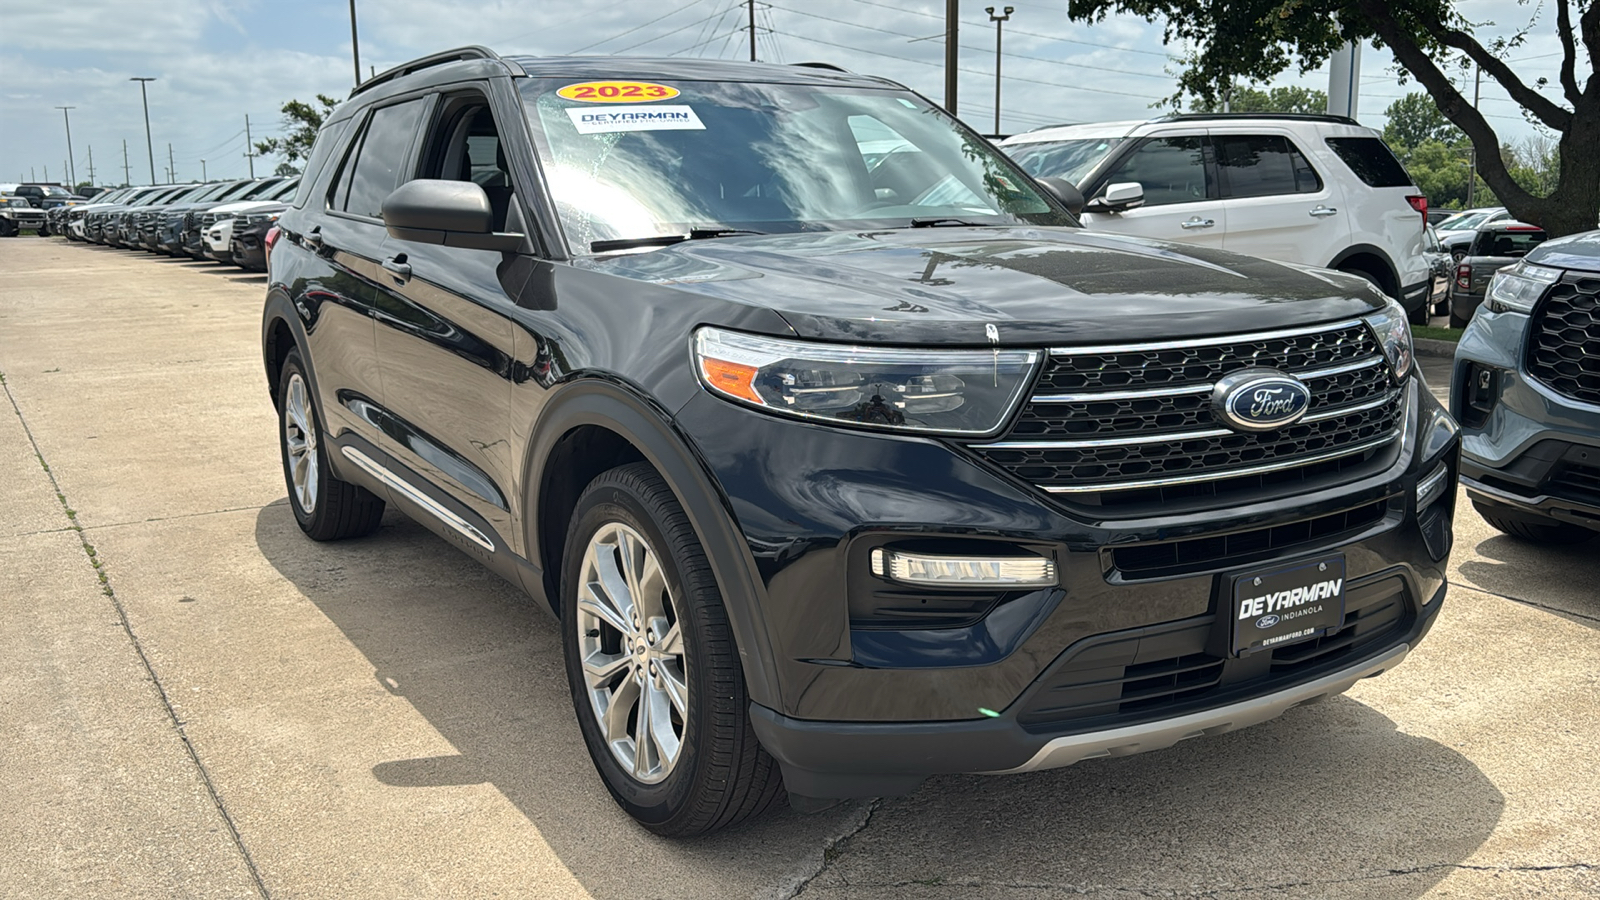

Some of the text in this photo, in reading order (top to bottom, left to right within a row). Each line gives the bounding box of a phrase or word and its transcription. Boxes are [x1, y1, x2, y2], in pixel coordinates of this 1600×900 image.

[574, 86, 669, 99] 2023
[581, 112, 689, 122] DEYARMAN
[1250, 387, 1295, 417] Ford
[1239, 578, 1342, 620] DEYARMAN
[1281, 605, 1323, 621] INDIANOLA
[1262, 627, 1315, 646] DEYARMANFORD.COM
